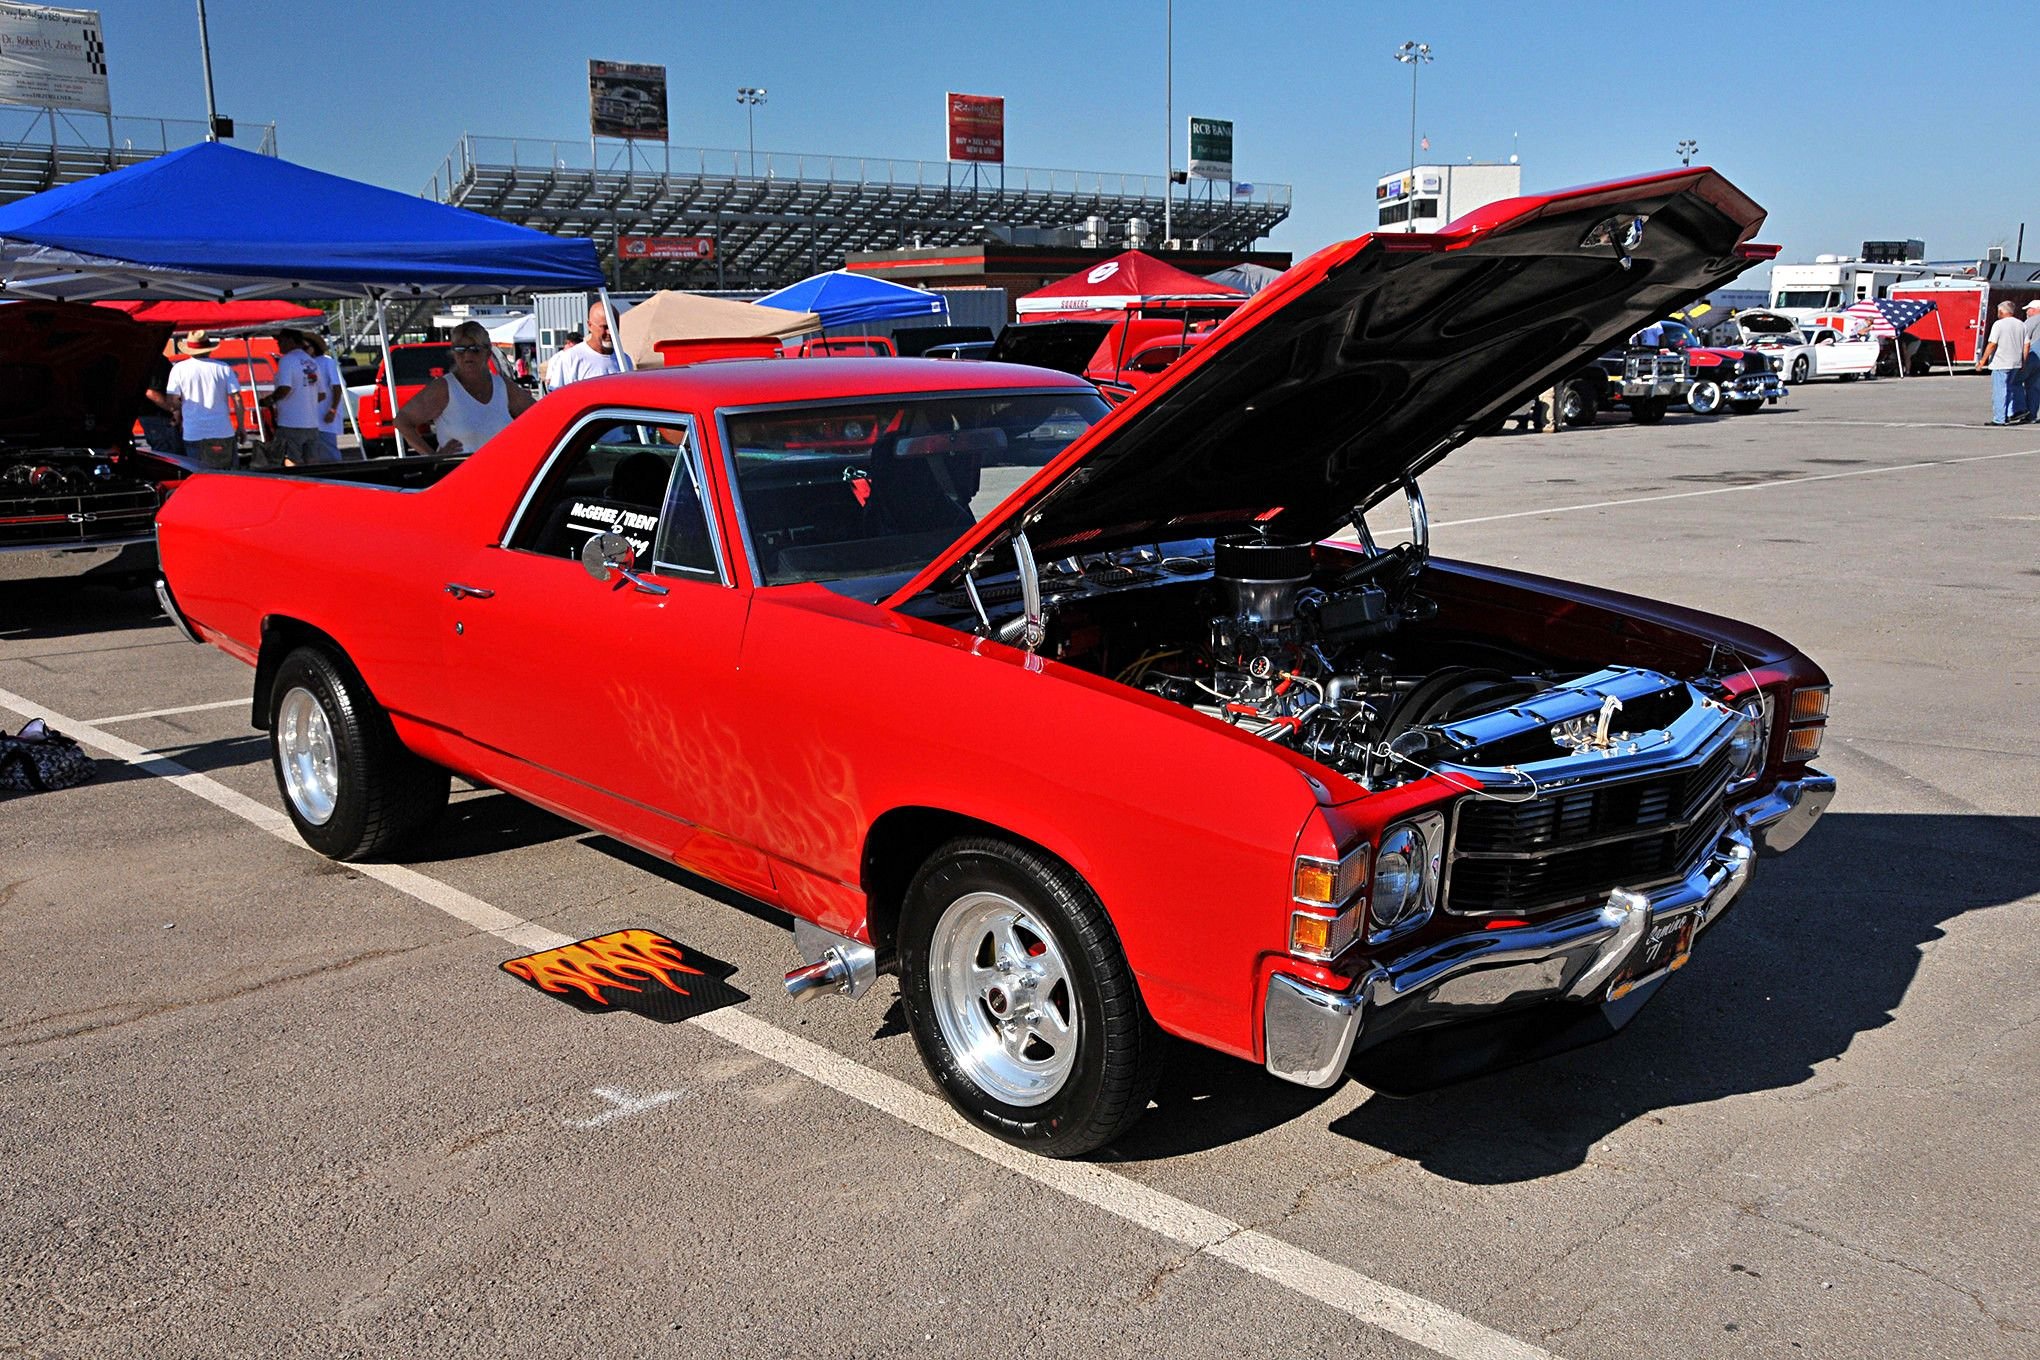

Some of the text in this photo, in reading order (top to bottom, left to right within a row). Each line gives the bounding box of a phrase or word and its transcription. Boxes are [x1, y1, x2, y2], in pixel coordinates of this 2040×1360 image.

[17, 35, 41, 47] Robert
[1193, 123, 1211, 135] RCB
[68, 511, 97, 523] SS
[1645, 940, 1663, 964] 71
